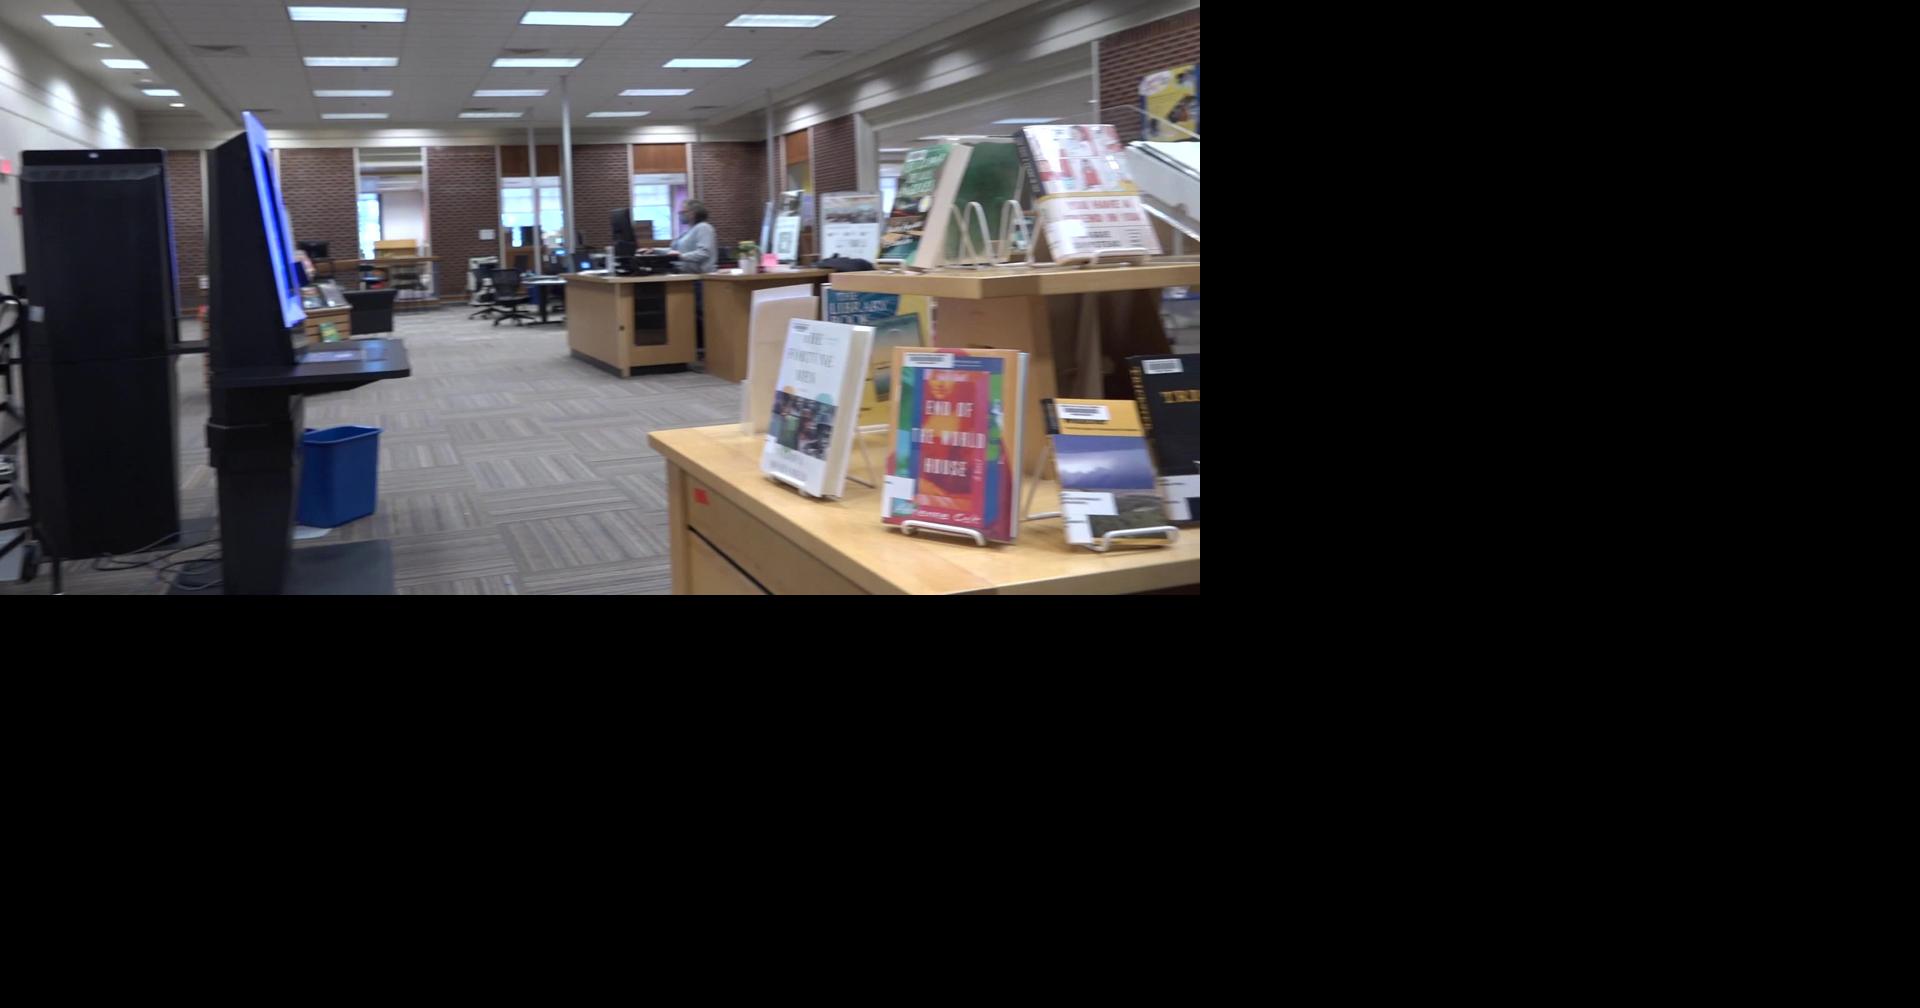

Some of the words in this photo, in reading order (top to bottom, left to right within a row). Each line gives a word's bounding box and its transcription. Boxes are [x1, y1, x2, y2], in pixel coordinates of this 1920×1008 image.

[925, 399, 951, 416] END
[956, 402, 976, 418] OF
[912, 427, 935, 445] THE
[940, 430, 987, 449] WORLD
[923, 458, 968, 477] HOUSE
